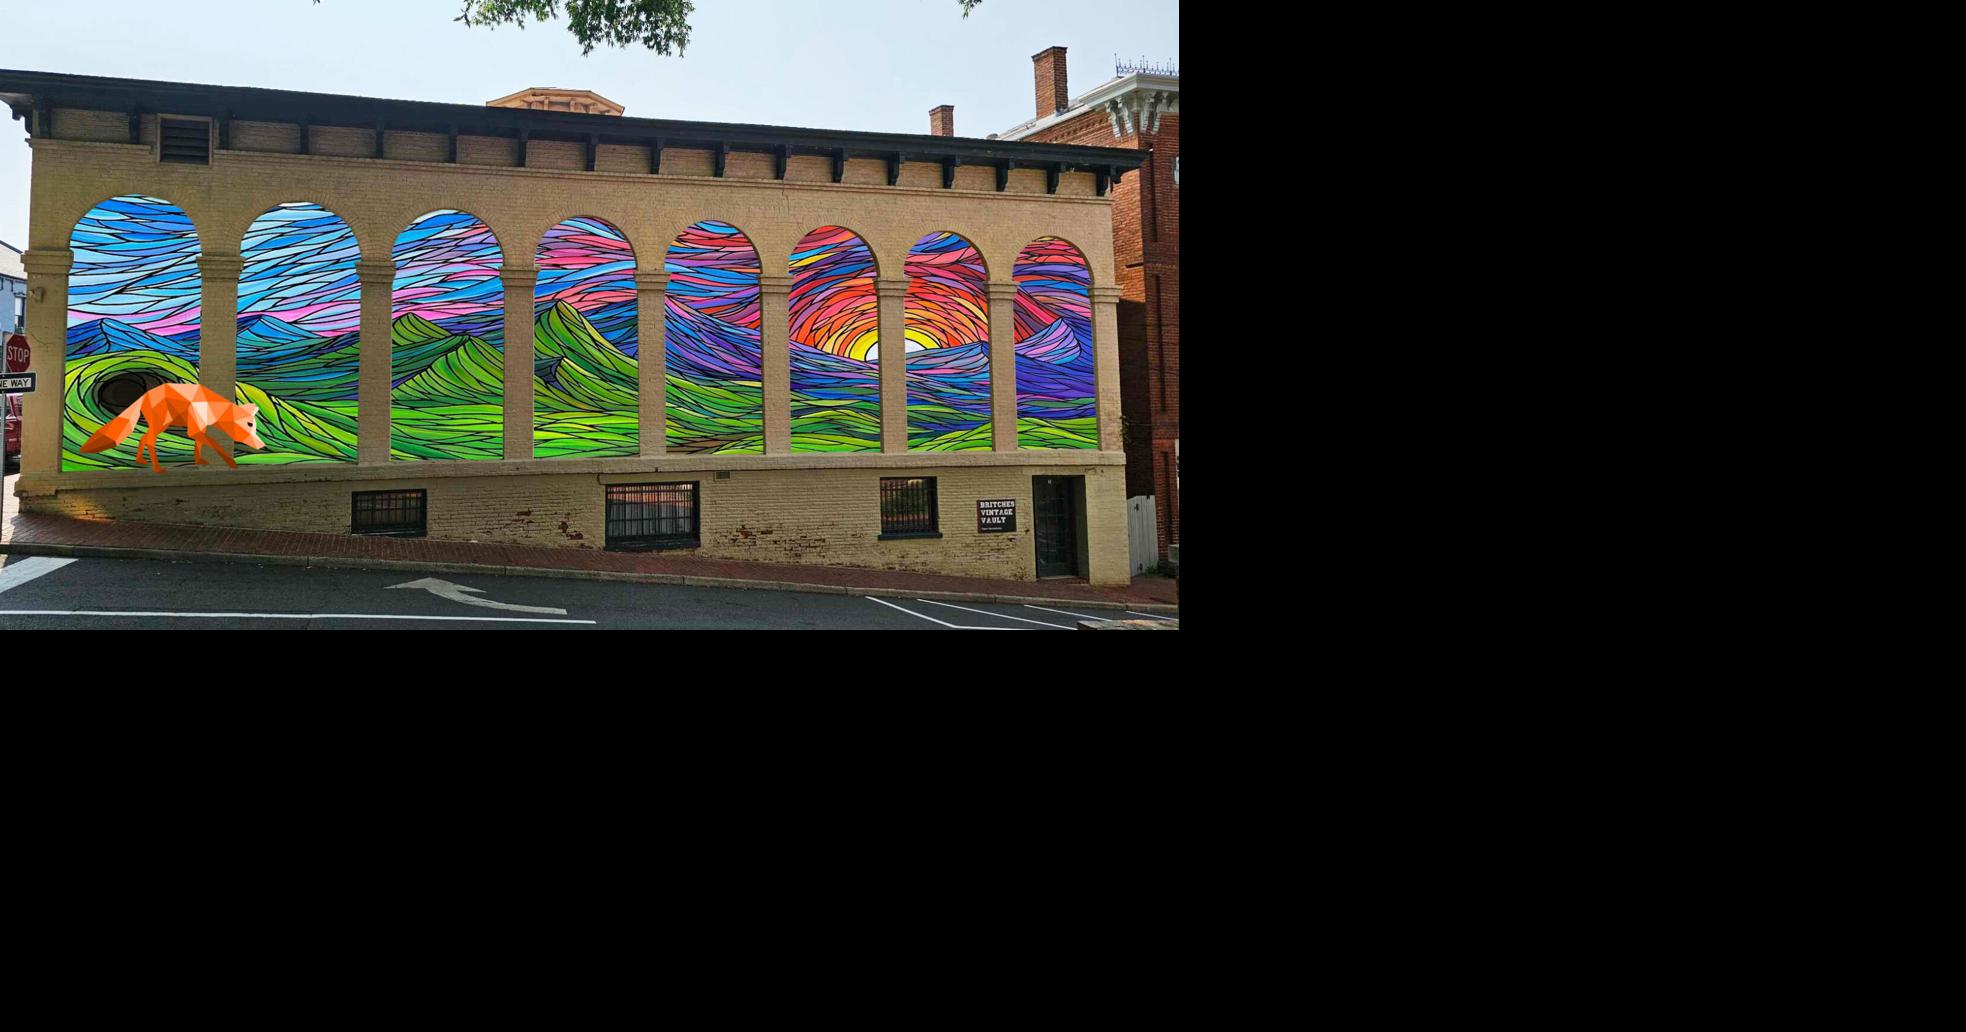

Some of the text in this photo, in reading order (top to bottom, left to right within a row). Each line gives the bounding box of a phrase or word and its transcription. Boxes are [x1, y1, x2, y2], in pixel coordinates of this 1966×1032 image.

[8, 346, 29, 363] STOP
[11, 379, 29, 387] WAY
[981, 516, 1006, 524] VAULT
